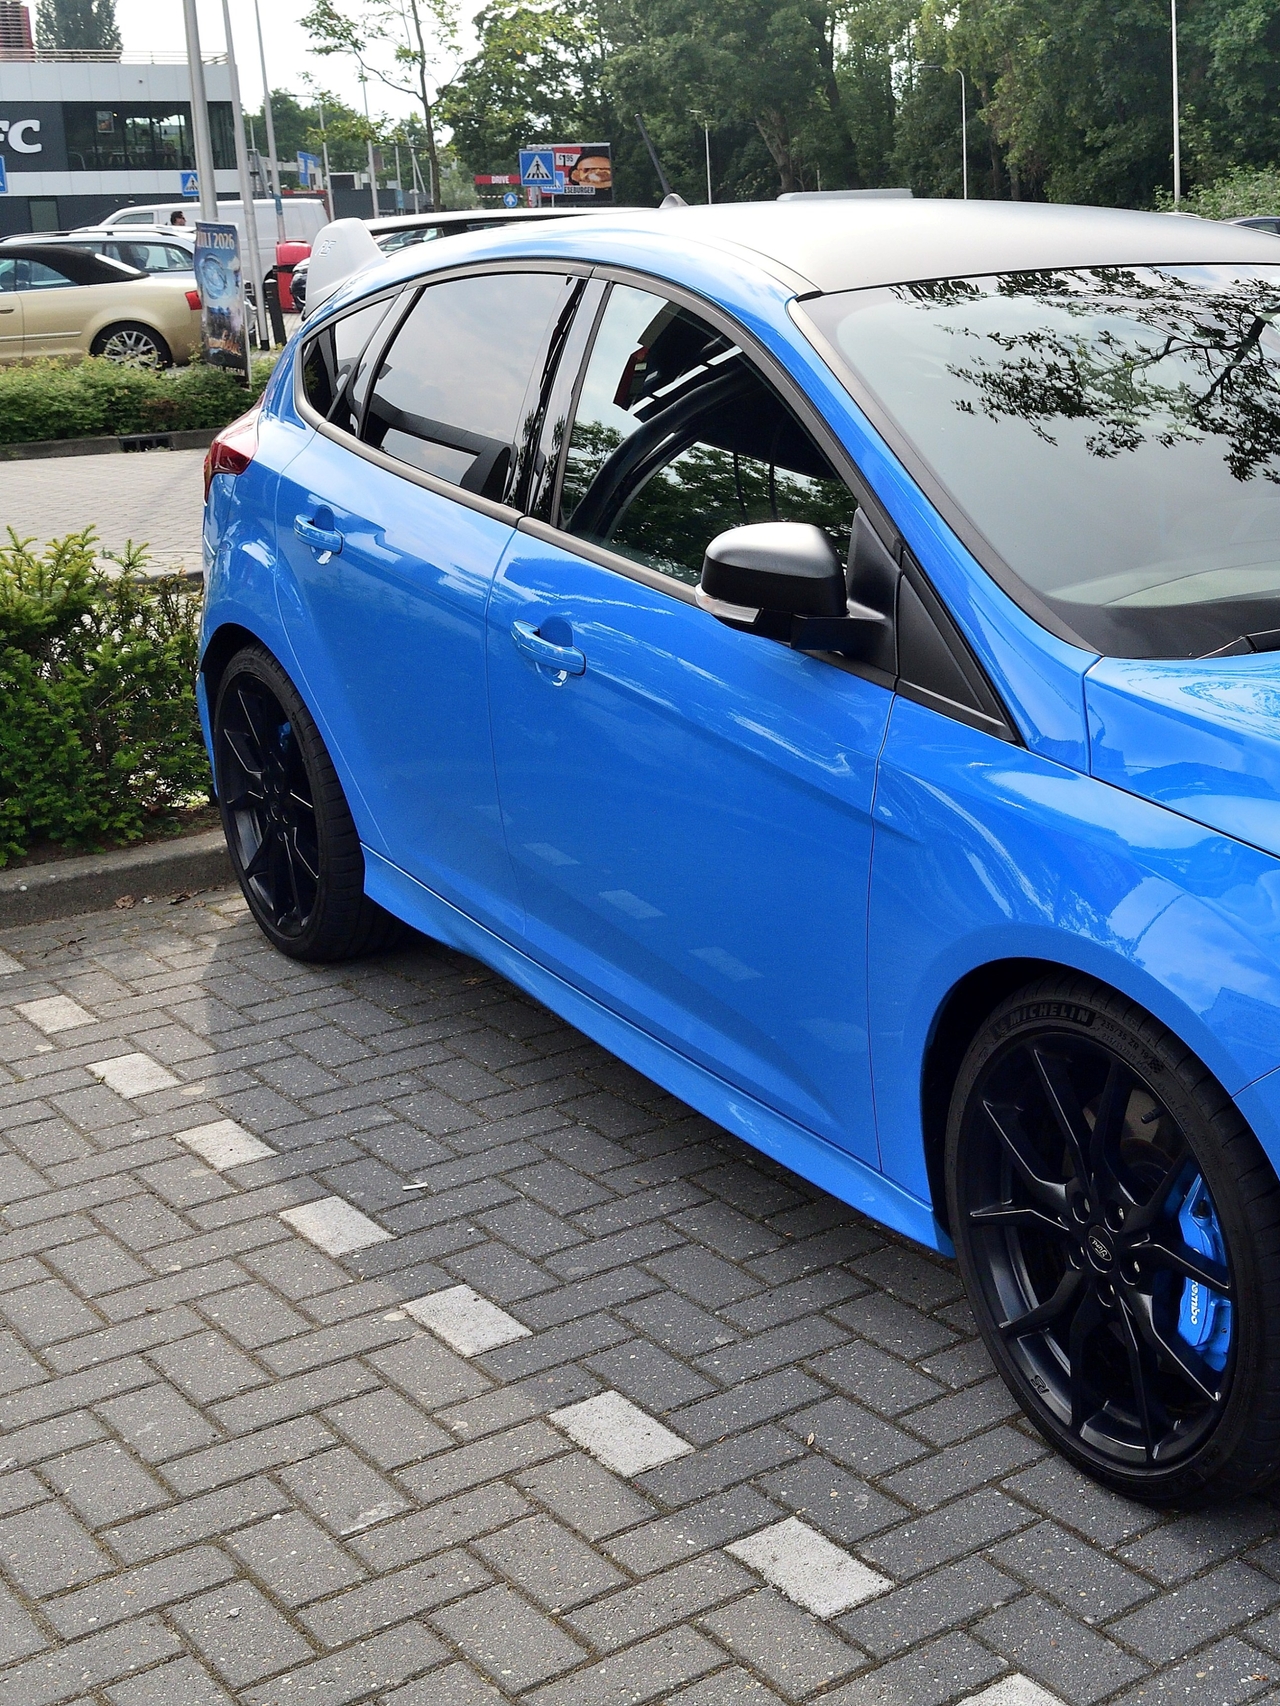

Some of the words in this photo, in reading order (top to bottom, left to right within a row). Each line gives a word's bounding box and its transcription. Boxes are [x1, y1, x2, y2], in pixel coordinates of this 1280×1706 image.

[491, 175, 510, 184] DRIVE
[564, 186, 595, 194] ESEBURGER
[213, 233, 235, 250] 2026
[1009, 1002, 1090, 1026] MICHELIN
[1191, 1280, 1200, 1325] rembo
